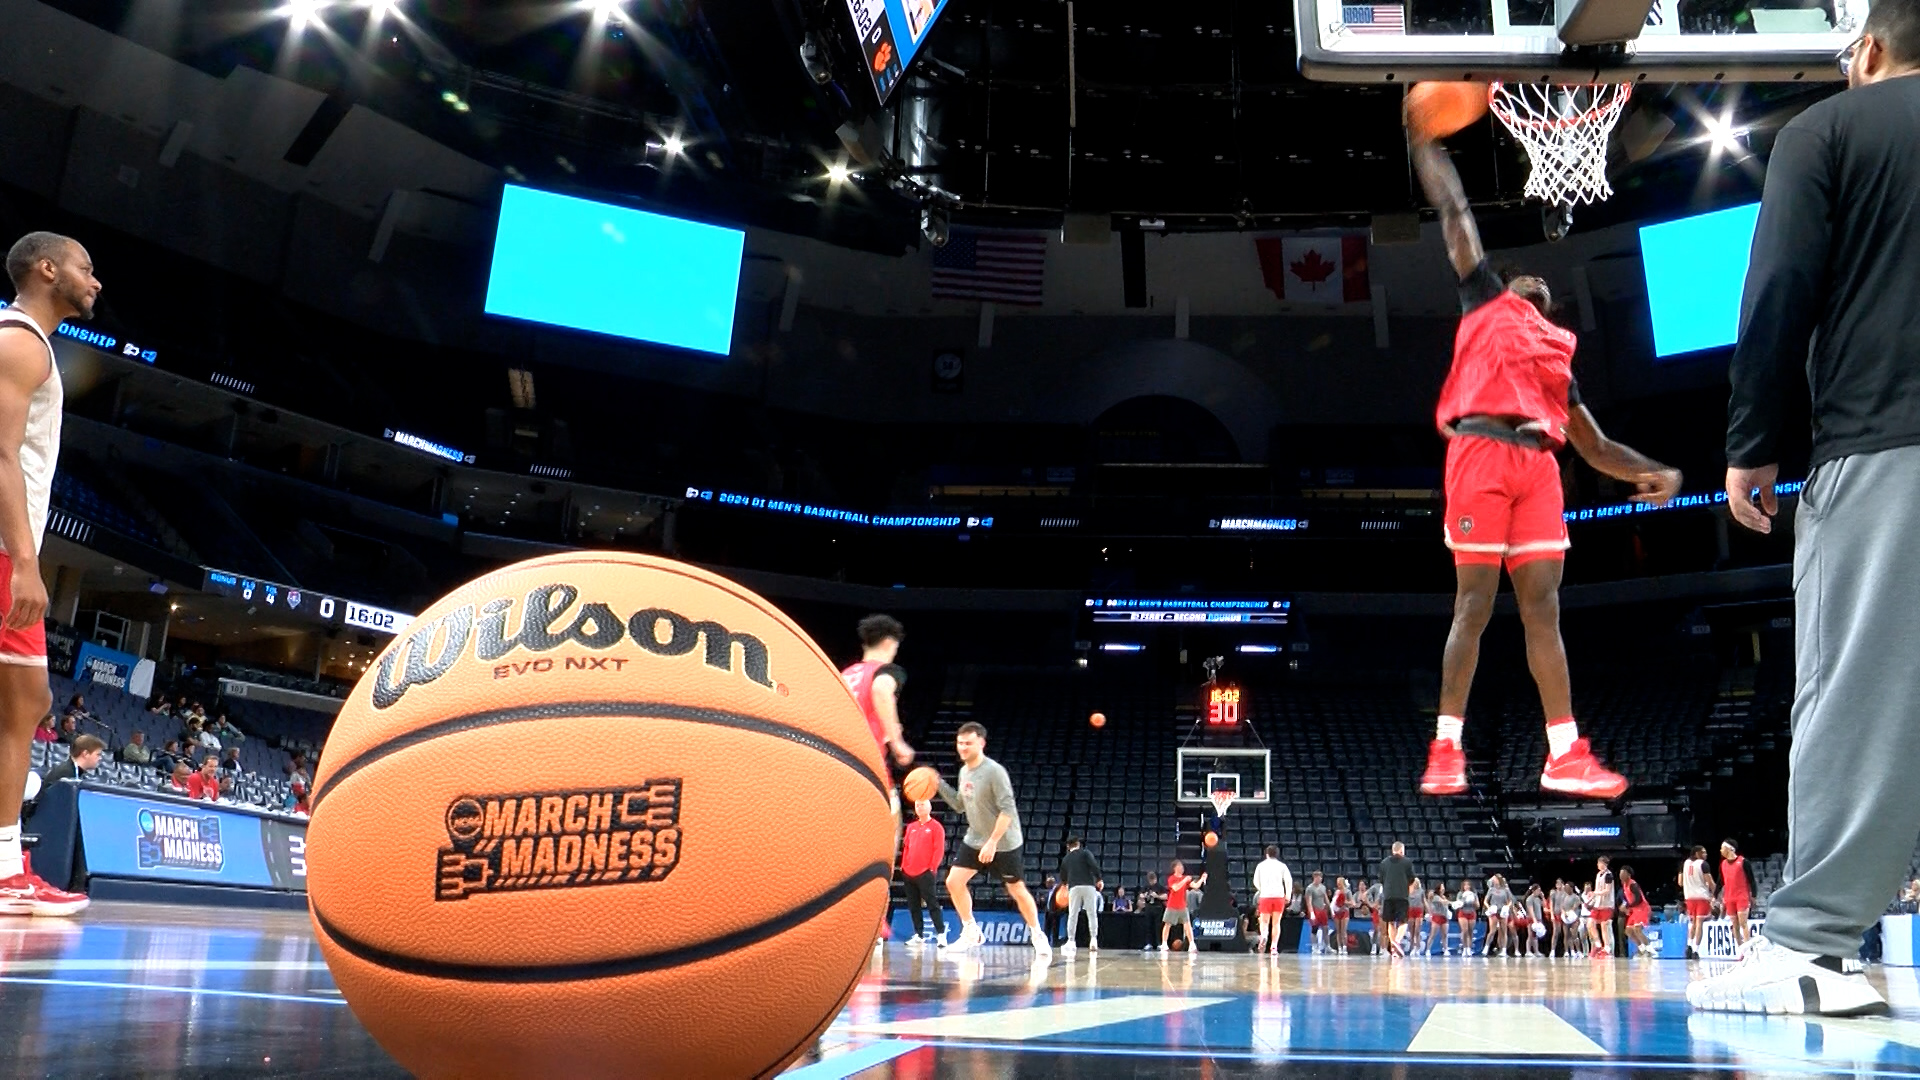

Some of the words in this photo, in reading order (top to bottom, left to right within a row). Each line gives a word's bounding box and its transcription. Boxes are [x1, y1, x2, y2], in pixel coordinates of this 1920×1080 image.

[803, 505, 869, 524] BASKETBALL
[872, 515, 961, 526] CHAMPIONSHIP
[319, 598, 335, 618] 0
[349, 605, 395, 630] 16:02
[371, 583, 776, 710] Wilson
[493, 658, 553, 680] EVO
[565, 657, 629, 672] NXT
[1211, 688, 1240, 702] 16:02
[1209, 701, 1238, 722] 30
[154, 815, 199, 840] MARCH
[483, 793, 613, 837] MARCH
[163, 837, 223, 864] MADNESS
[500, 829, 678, 876] MADNESS
